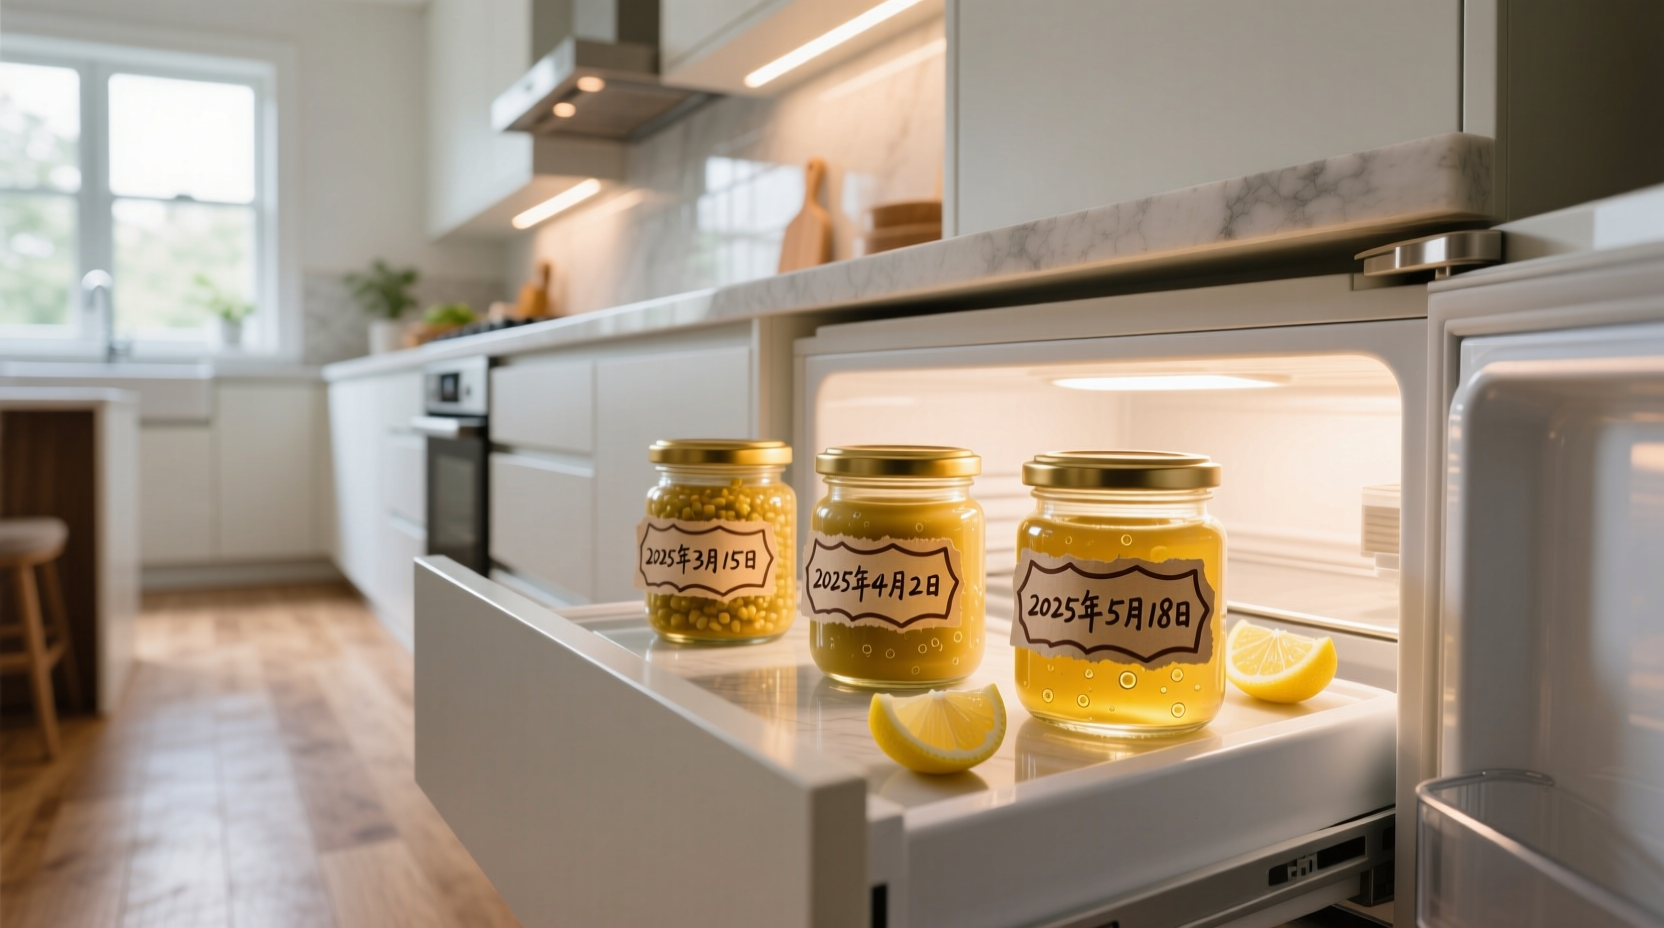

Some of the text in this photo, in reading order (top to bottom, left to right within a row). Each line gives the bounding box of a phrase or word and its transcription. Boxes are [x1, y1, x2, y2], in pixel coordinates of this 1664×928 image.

[645, 544, 757, 575] 2025年3月15日
[813, 565, 941, 603] 2025年4月2日
[1027, 589, 1190, 634] 2025年5月18日
